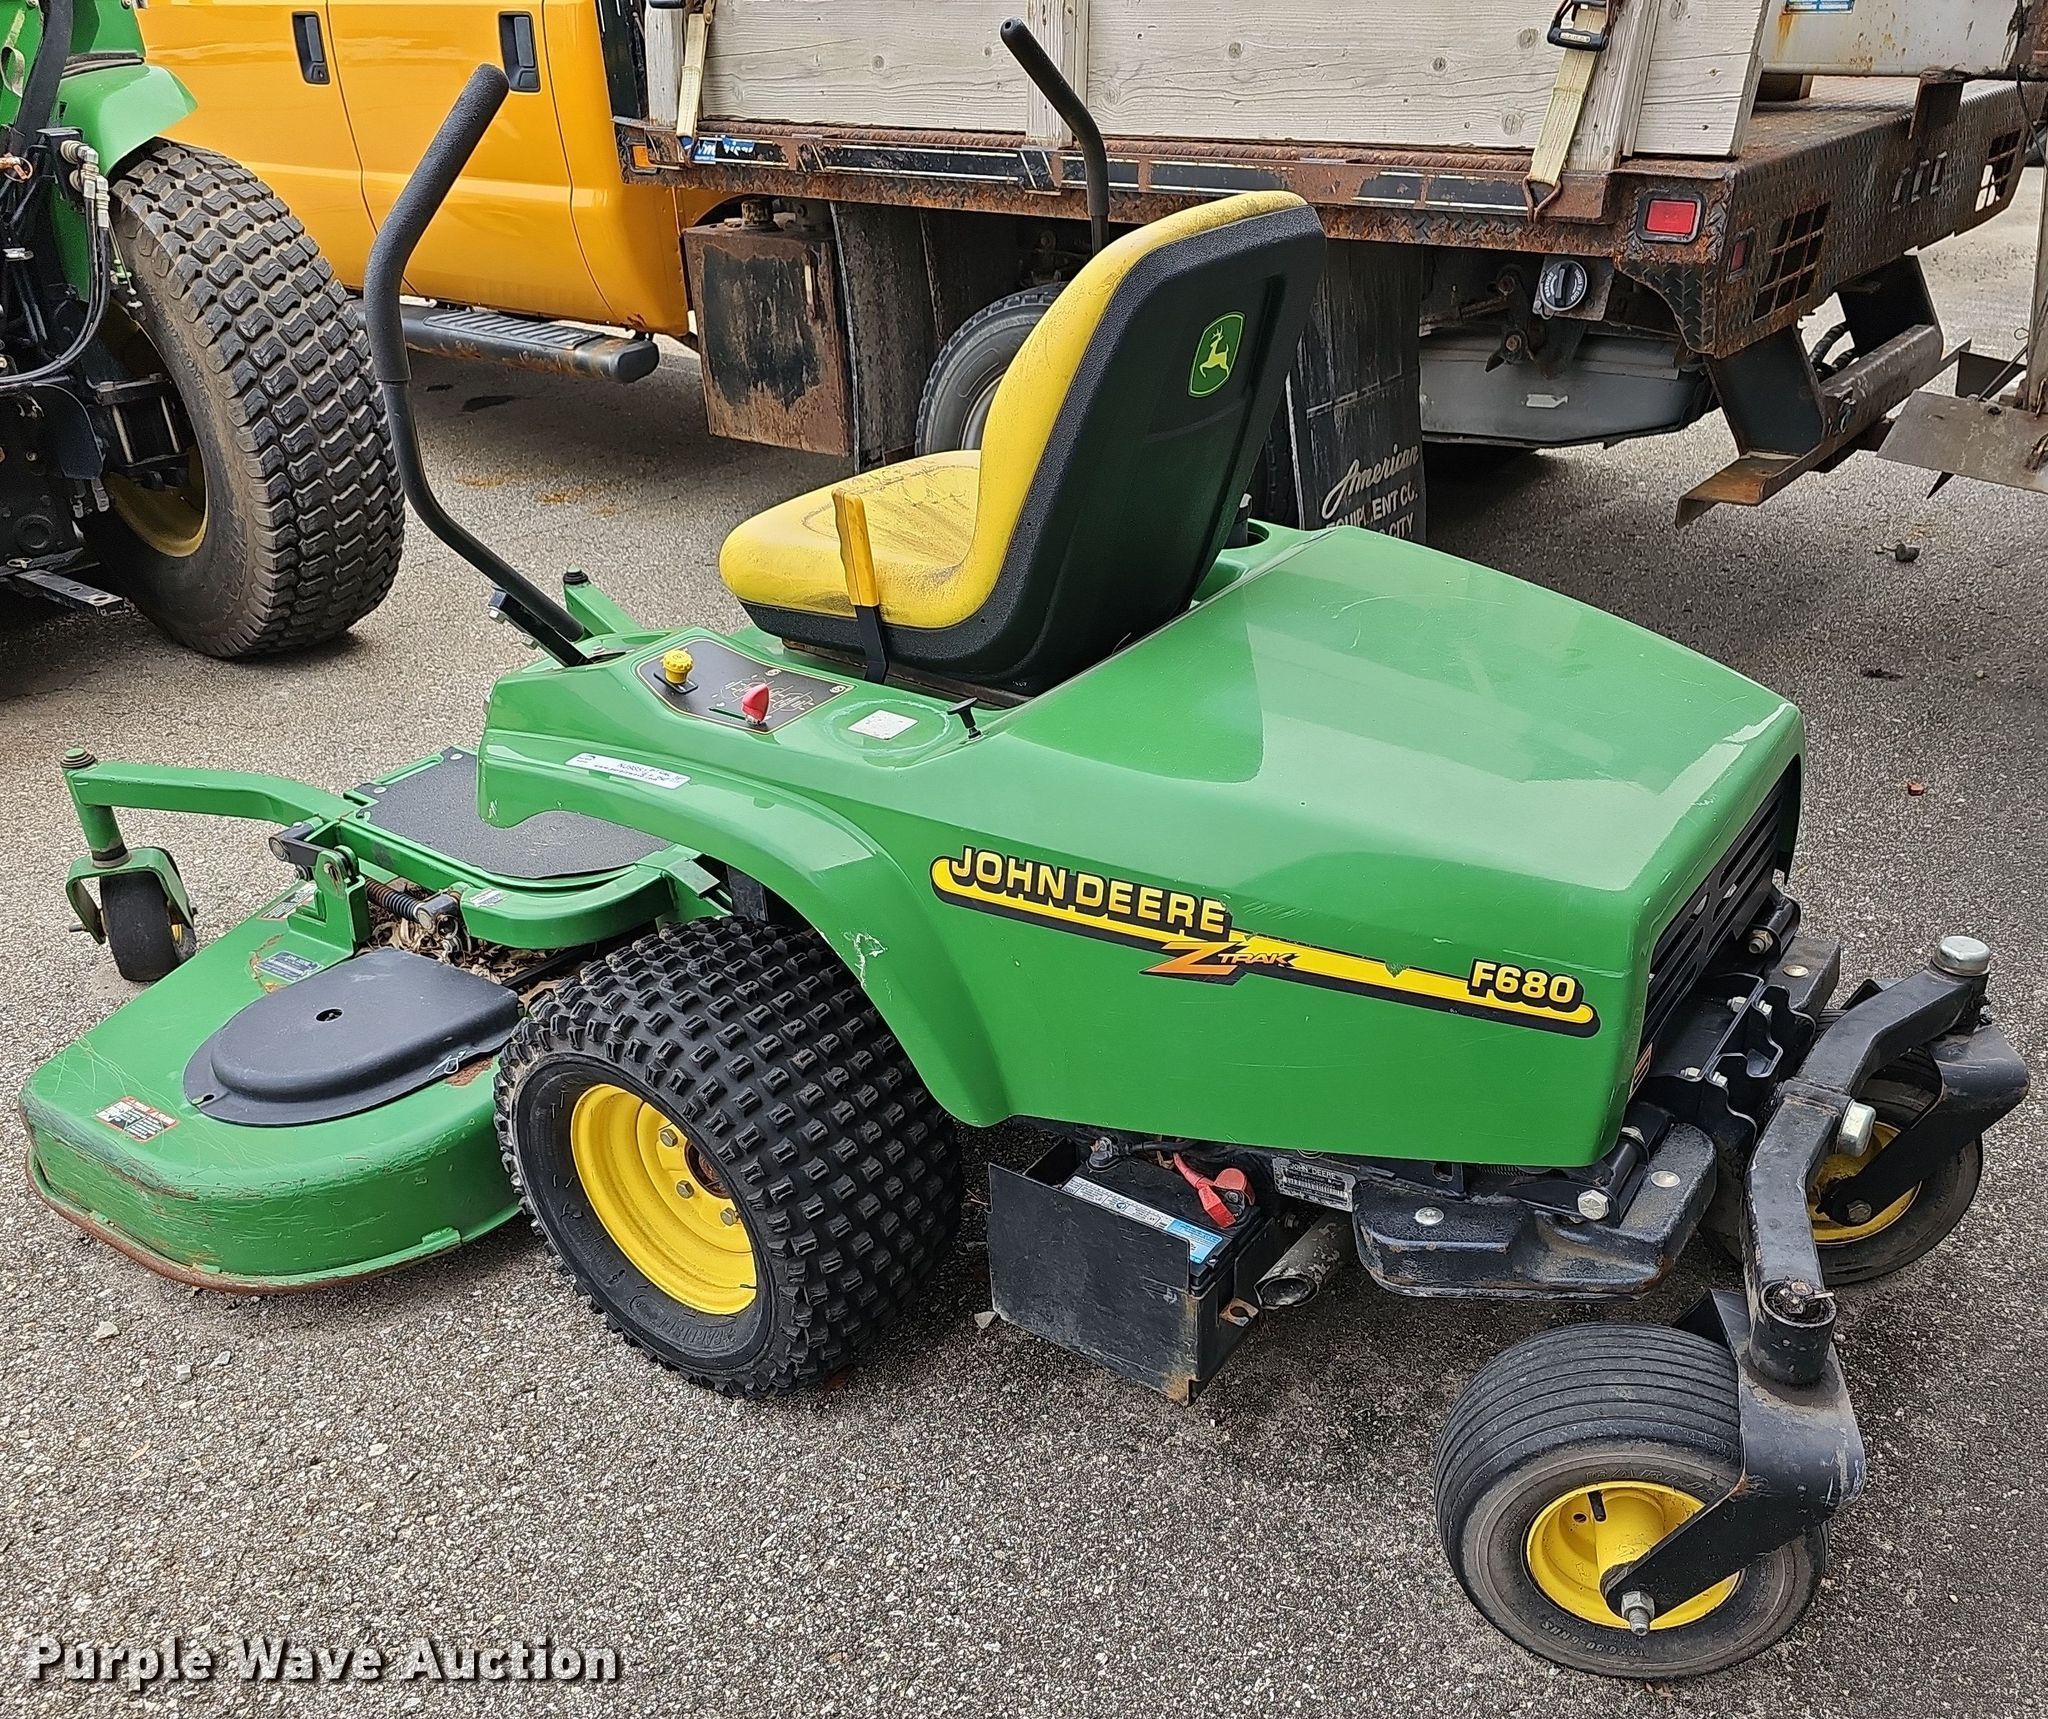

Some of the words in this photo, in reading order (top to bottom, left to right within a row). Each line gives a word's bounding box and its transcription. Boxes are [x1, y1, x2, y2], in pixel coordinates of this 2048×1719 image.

[1322, 444, 1419, 519] American
[1388, 512, 1414, 538] CITY
[951, 847, 1066, 901] JOHN
[1076, 872, 1228, 935] DEERE
[1471, 960, 1577, 1004] F680
[1311, 1167, 1336, 1180] DEERE
